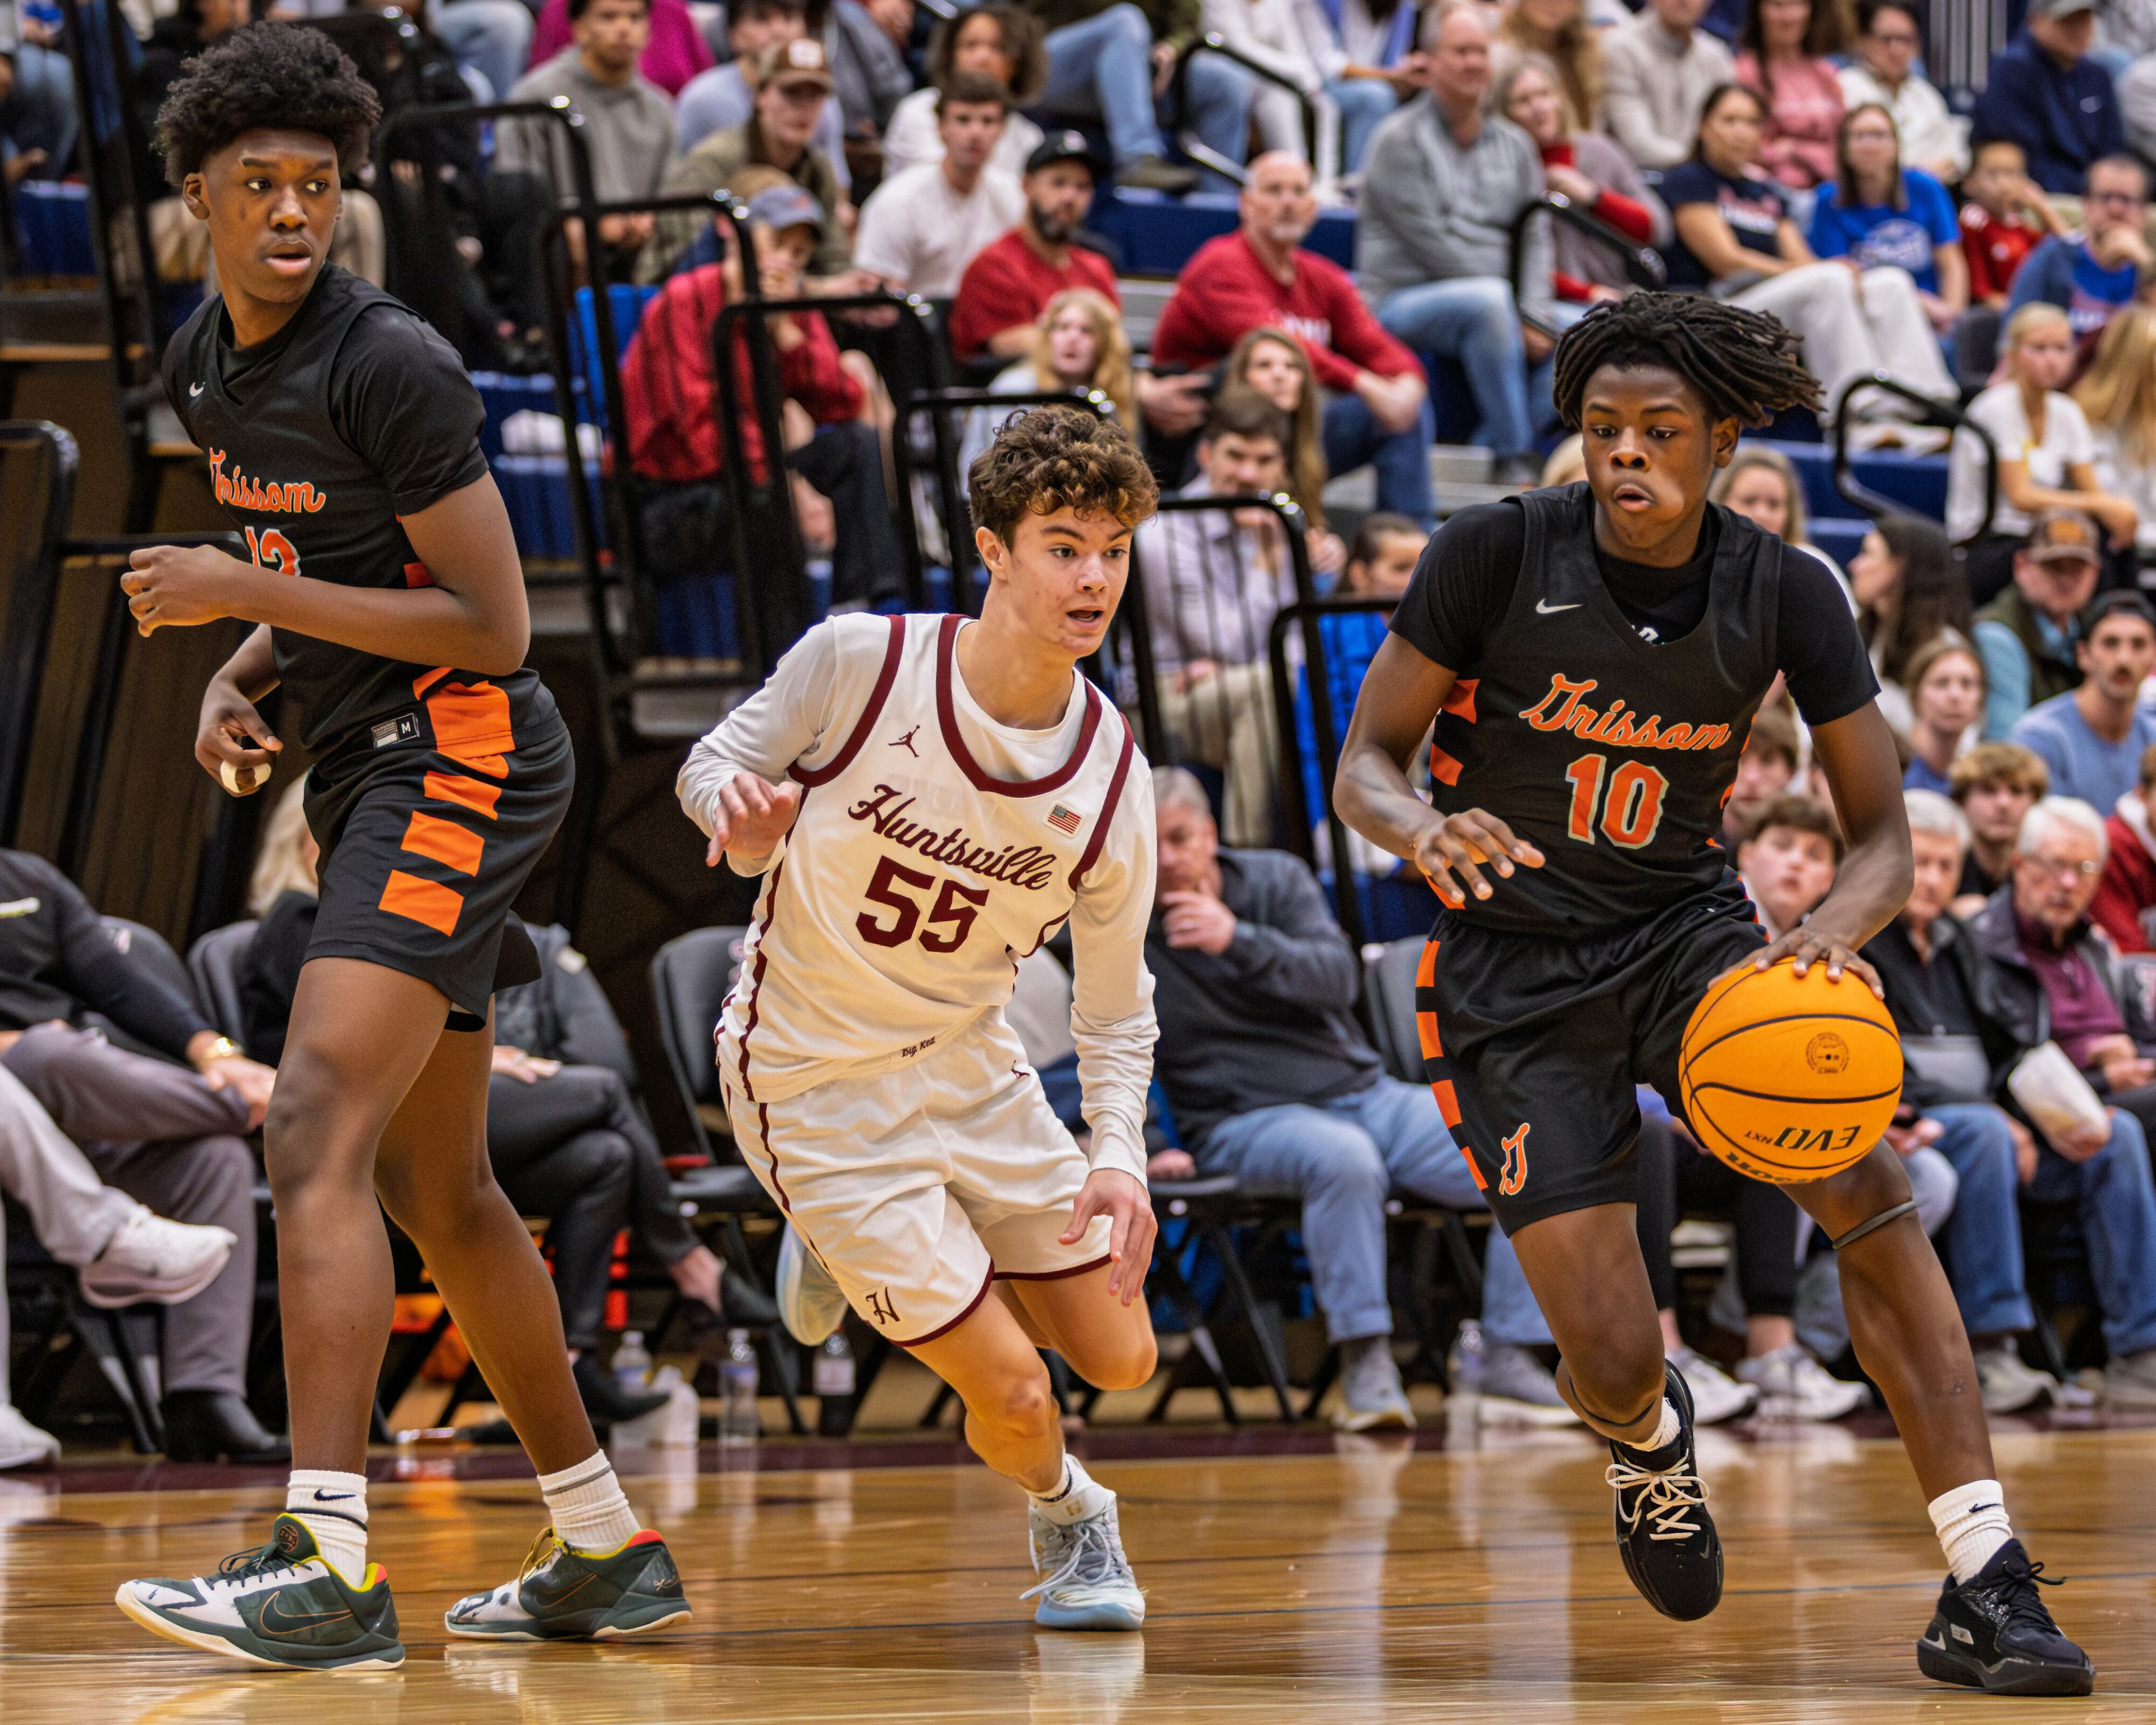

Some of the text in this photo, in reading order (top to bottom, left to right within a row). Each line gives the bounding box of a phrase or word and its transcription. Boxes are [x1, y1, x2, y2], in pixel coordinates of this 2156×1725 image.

[401, 721, 411, 734] M
[1518, 673, 1732, 751] Grissom
[847, 783, 1057, 891] Huntsville
[1565, 753, 1670, 850] 10
[855, 854, 990, 953] 55
[1773, 1125, 1861, 1151] EVO
[865, 1286, 901, 1325] H
